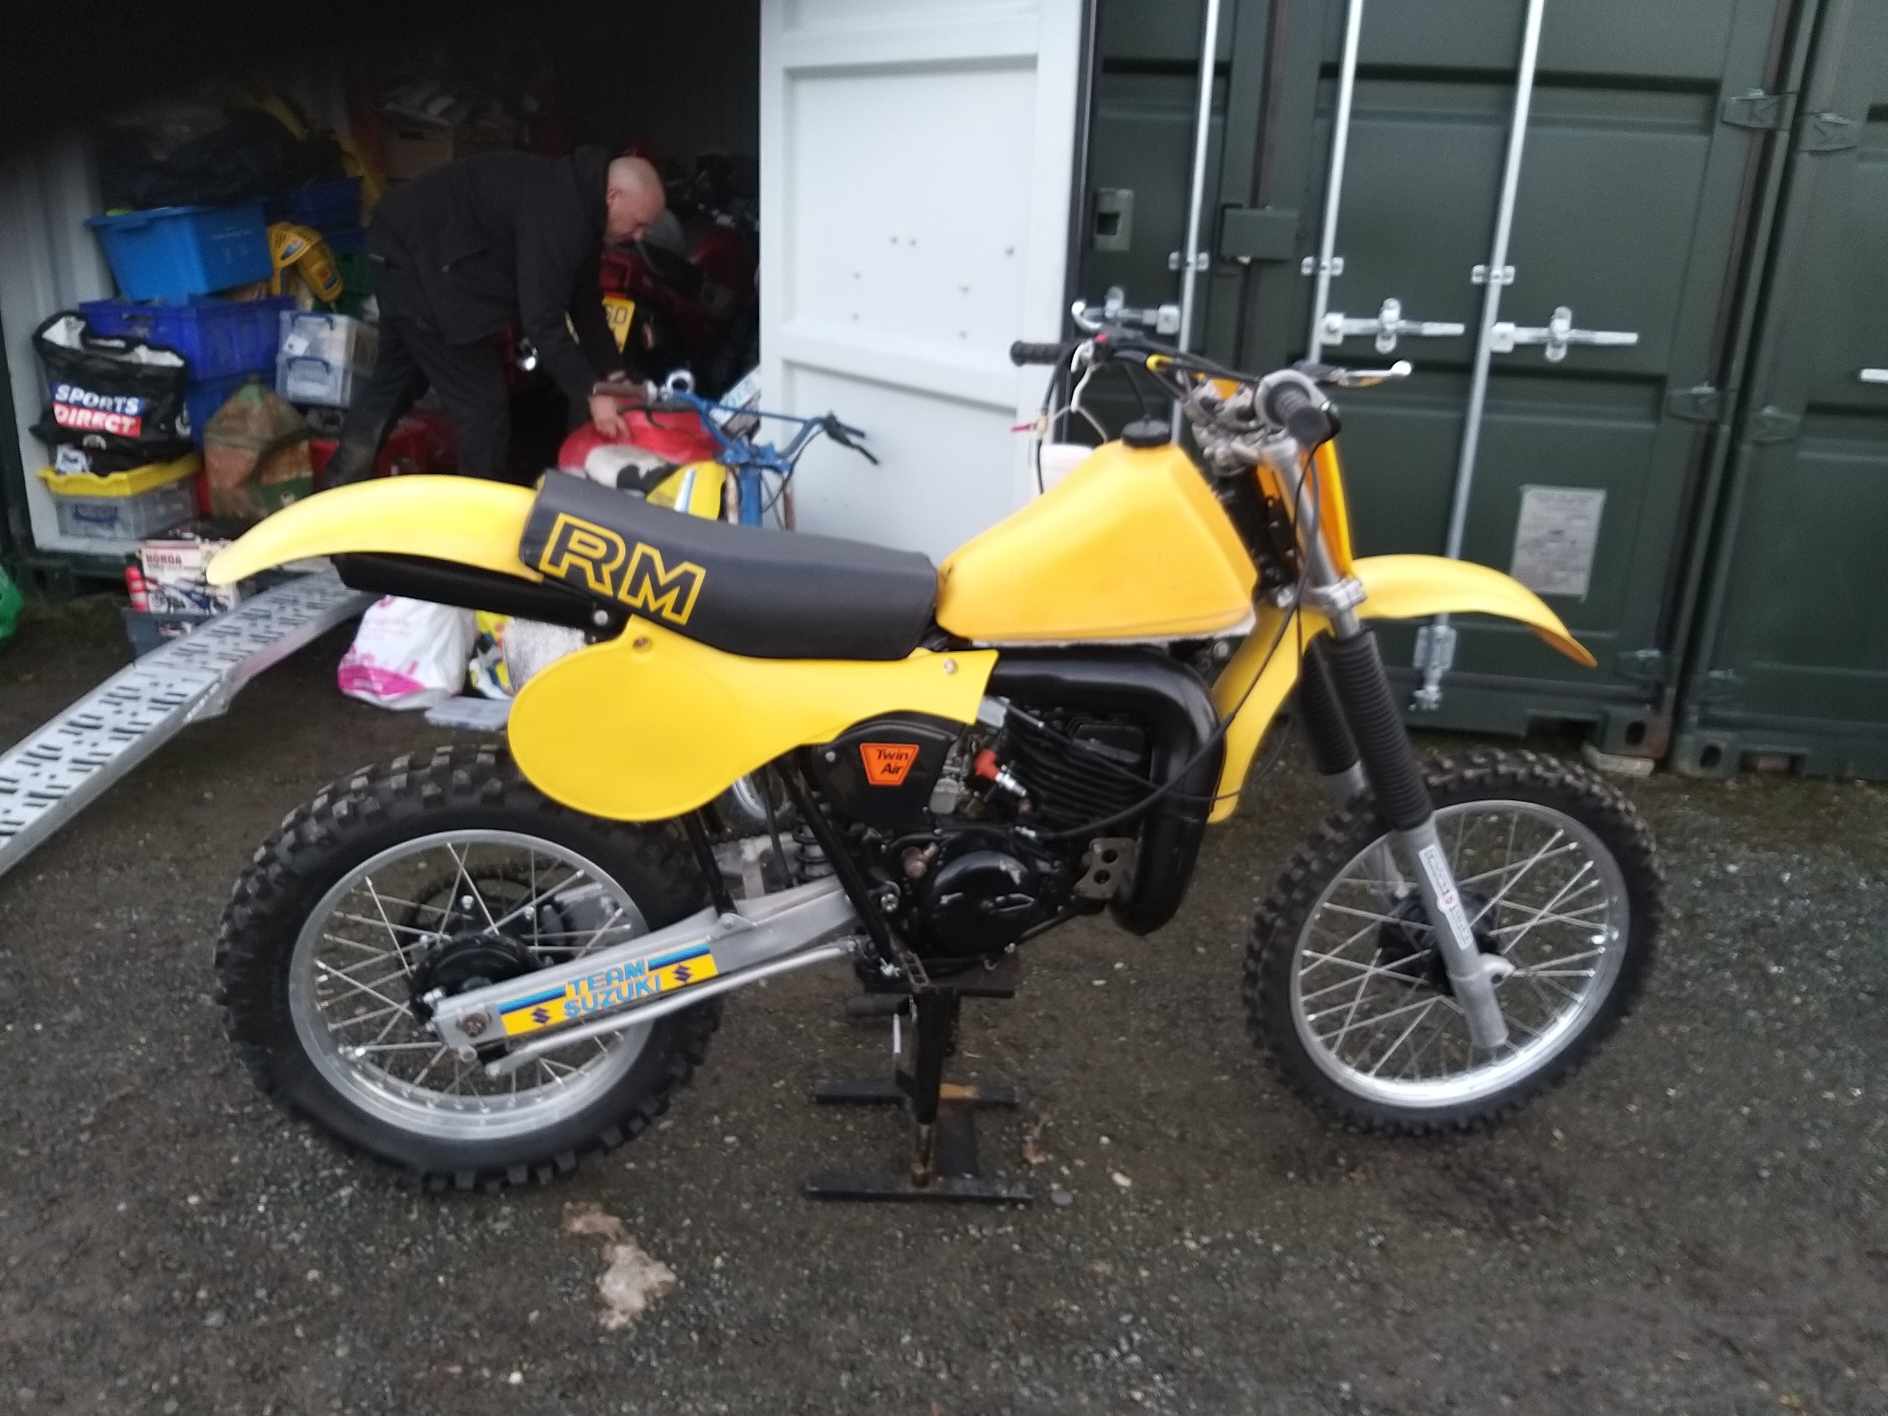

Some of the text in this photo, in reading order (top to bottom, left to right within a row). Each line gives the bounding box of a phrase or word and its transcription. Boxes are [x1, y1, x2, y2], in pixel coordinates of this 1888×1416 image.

[55, 384, 140, 416] SPORTS
[53, 403, 137, 434] DIRECT
[538, 512, 706, 625] RM
[876, 748, 909, 761] Twin
[880, 763, 902, 775] Air
[568, 960, 645, 996] TEAM
[564, 975, 660, 1018] SUZUKI
